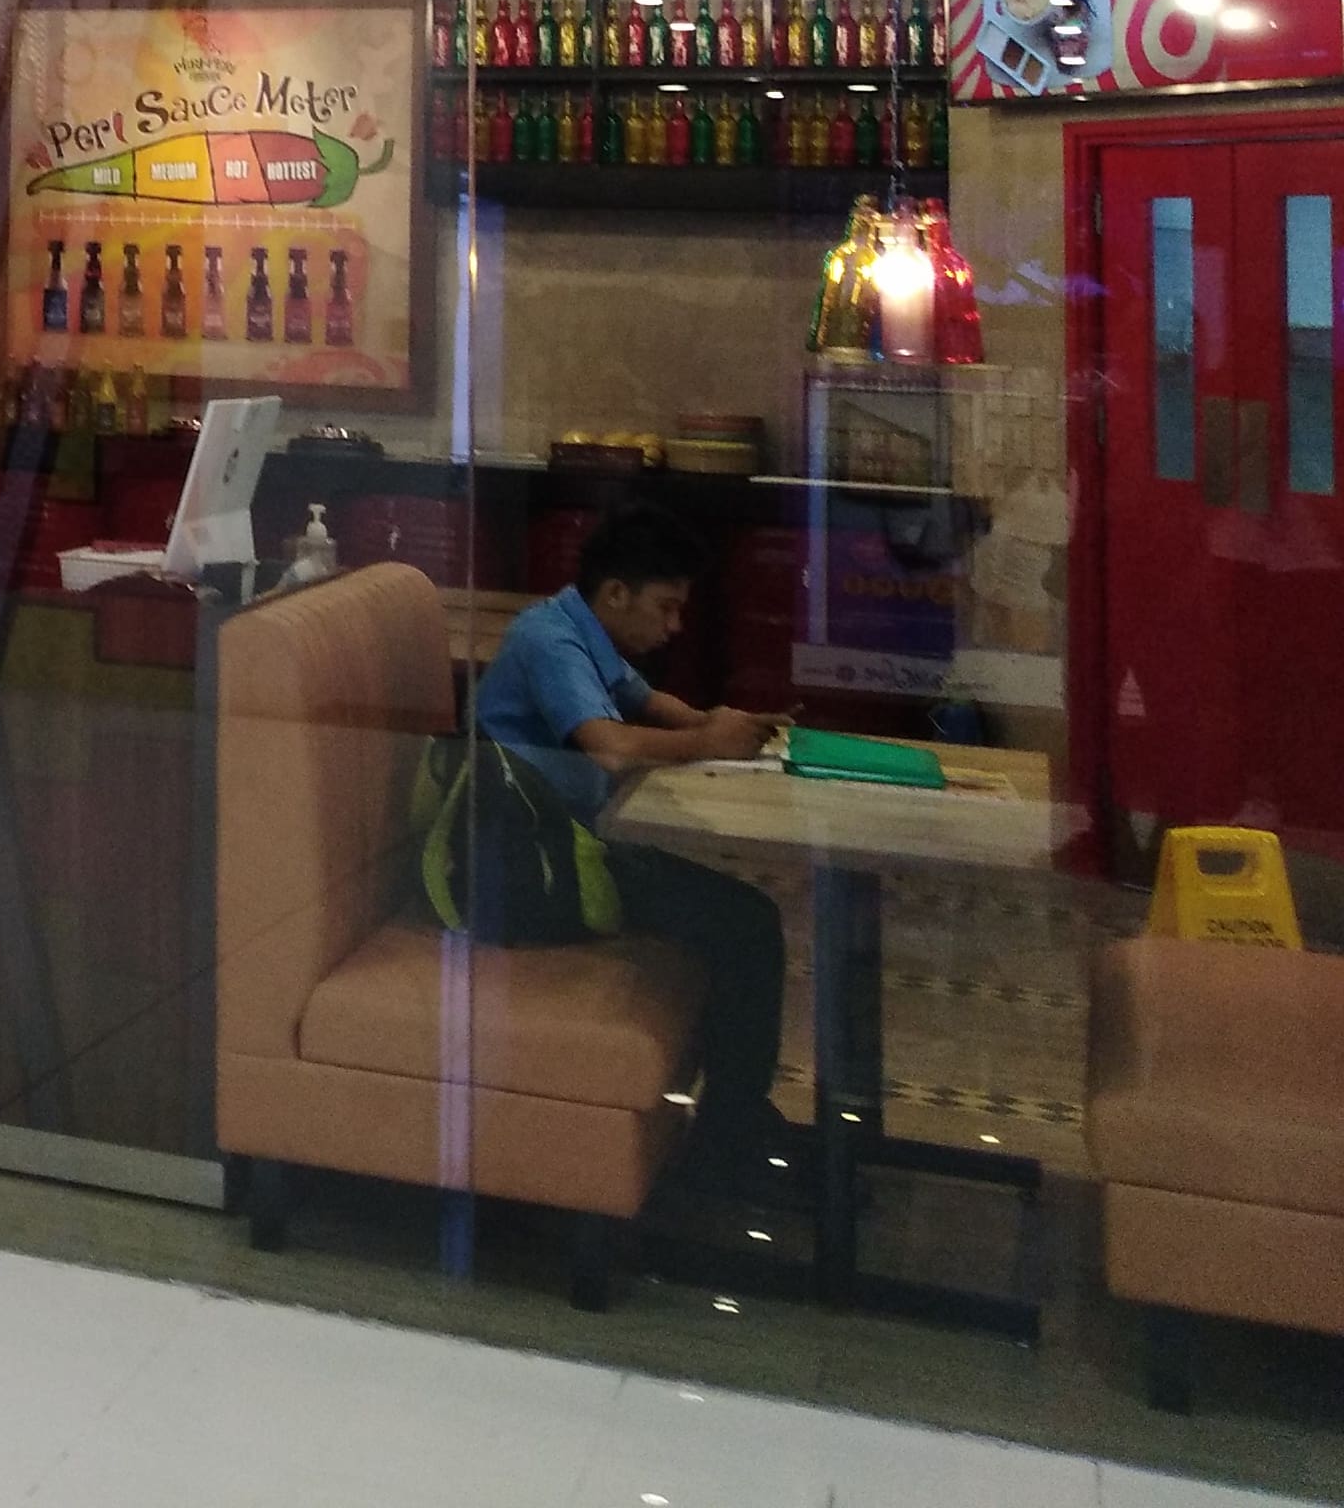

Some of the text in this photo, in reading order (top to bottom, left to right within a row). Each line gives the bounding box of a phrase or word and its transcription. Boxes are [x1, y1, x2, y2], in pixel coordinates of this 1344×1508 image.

[47, 112, 128, 159] Peri
[255, 71, 359, 124] Meter
[92, 158, 318, 186] MILD MEDIUM HOT HOTTEST
